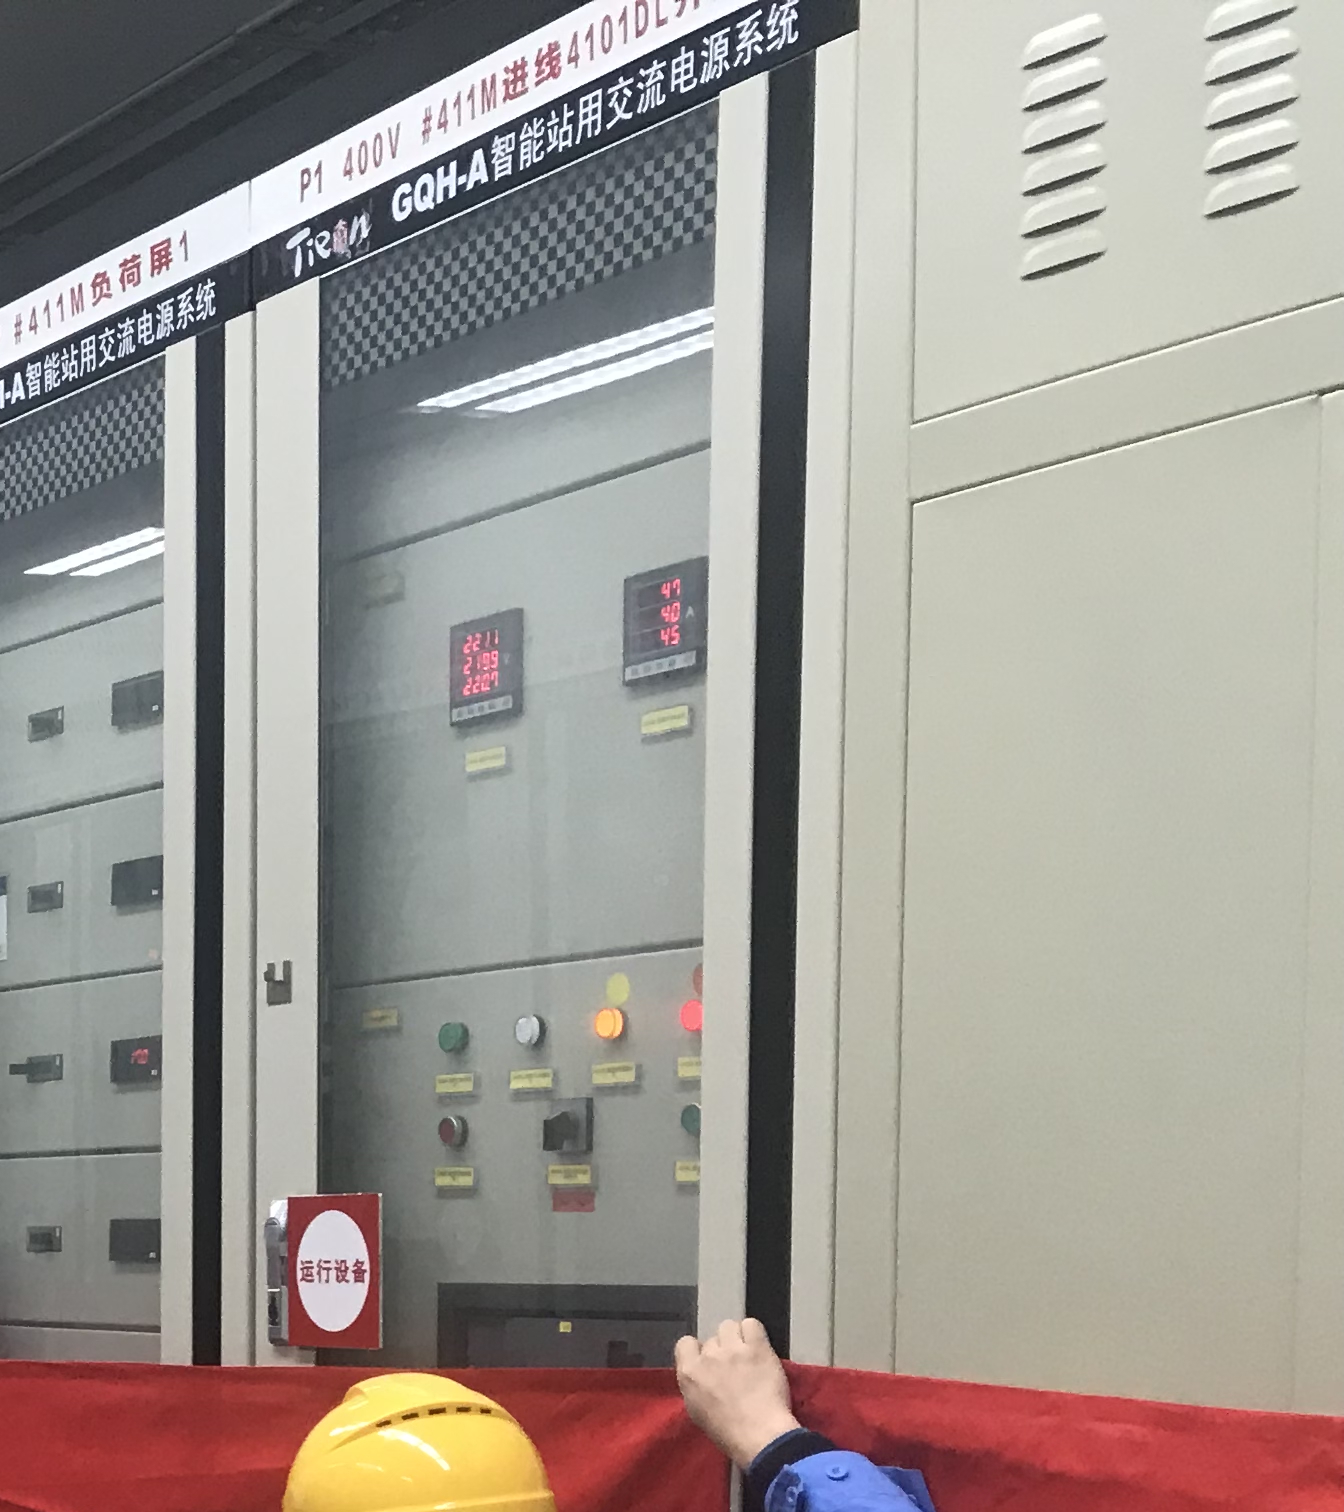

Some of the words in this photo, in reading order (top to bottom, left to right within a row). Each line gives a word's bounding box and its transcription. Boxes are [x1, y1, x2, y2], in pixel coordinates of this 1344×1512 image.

[391, 0, 800, 223] GQH-A智能站用交流电源系统
[300, 159, 324, 203] P1
[343, 122, 402, 182] 400V
[13, 229, 191, 346] #411M负荷屏1
[299, 1258, 367, 1284] 运行设备
